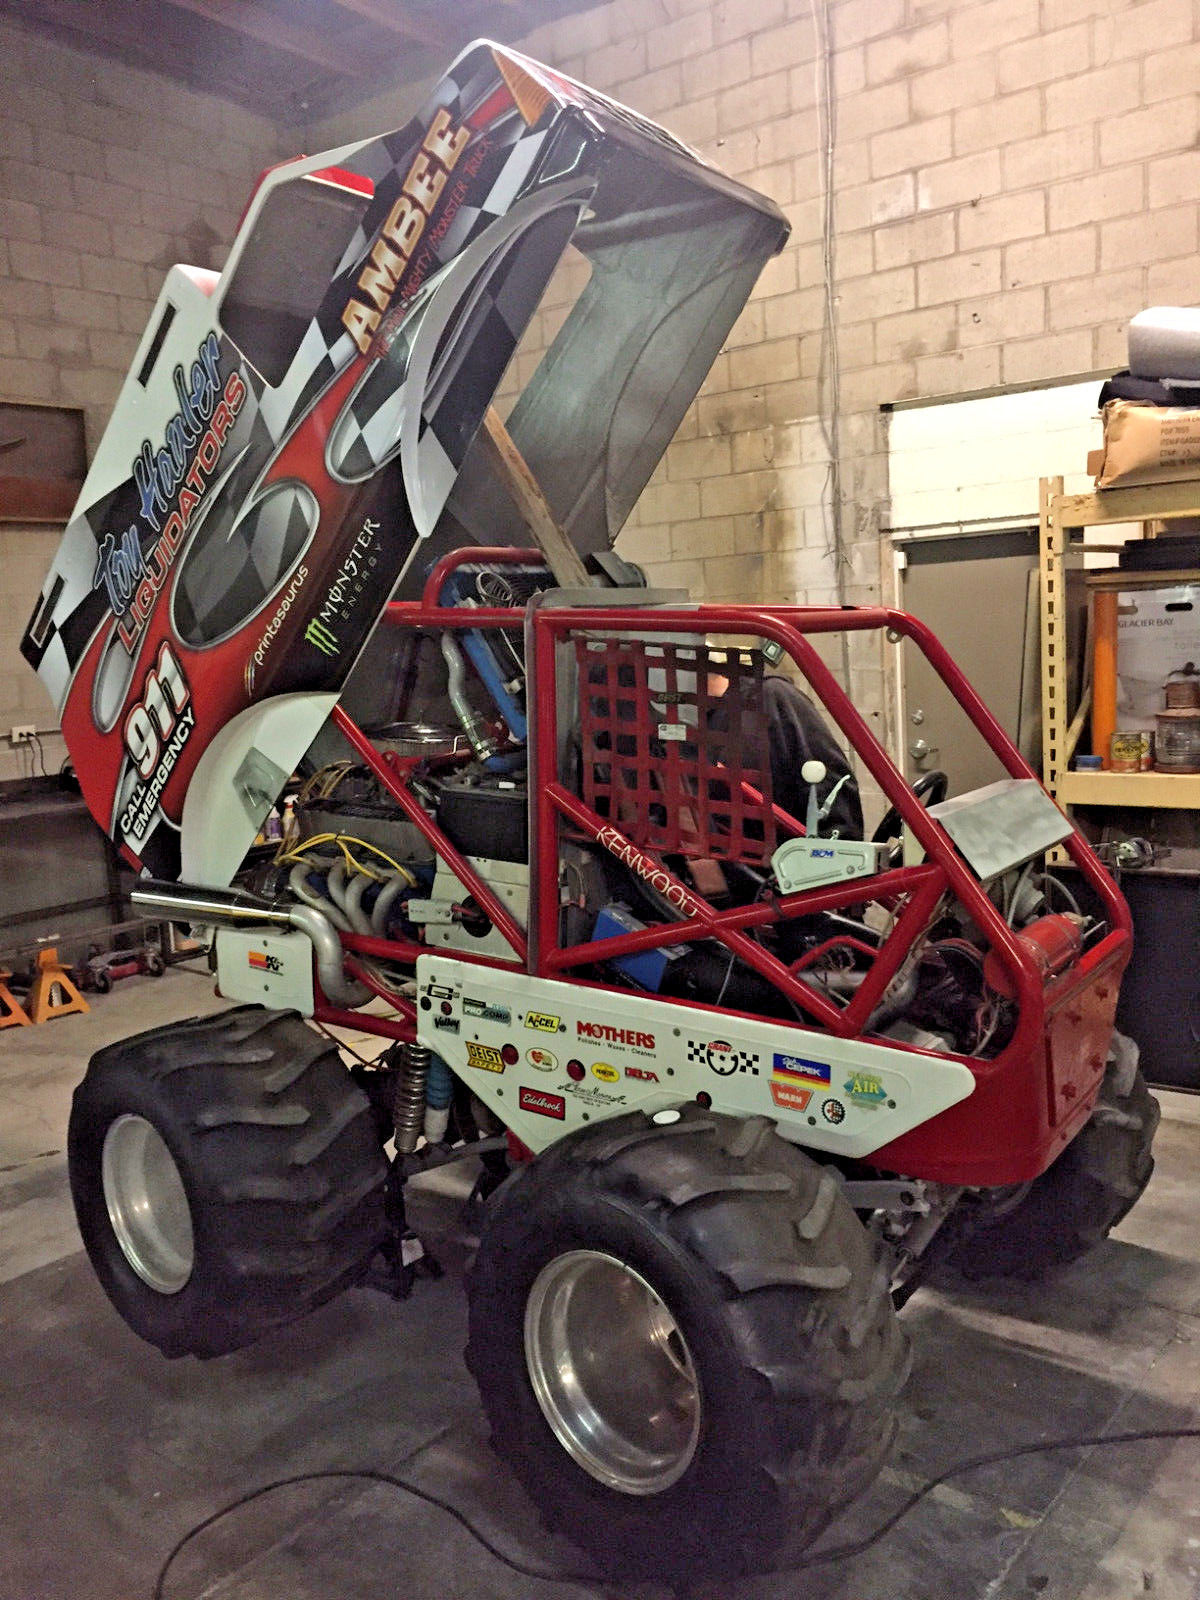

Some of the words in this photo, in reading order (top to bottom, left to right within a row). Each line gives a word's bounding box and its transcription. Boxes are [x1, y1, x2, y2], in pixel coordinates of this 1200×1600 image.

[341, 107, 471, 355] AMBEE
[401, 251, 433, 300] MIGHTY
[428, 181, 469, 248] MONSTER
[462, 138, 495, 179] TRUCK
[116, 370, 247, 654] LIQUIDATORS
[319, 518, 381, 623] MONSTER
[340, 543, 383, 620] ENERGY
[253, 564, 309, 667] printosaurus
[1118, 618, 1154, 629] GLACIER
[1156, 617, 1175, 627] BAY
[124, 640, 190, 781] 911
[119, 782, 147, 835] CALL
[133, 706, 197, 841] EMERGENCY
[596, 825, 698, 918] KENWOOD
[469, 1045, 500, 1063] DEIST
[527, 1014, 557, 1030] ACCEL
[576, 1020, 656, 1050] MOTHERS
[522, 1093, 562, 1113] Edelbrock
[852, 1080, 880, 1094] AIR
